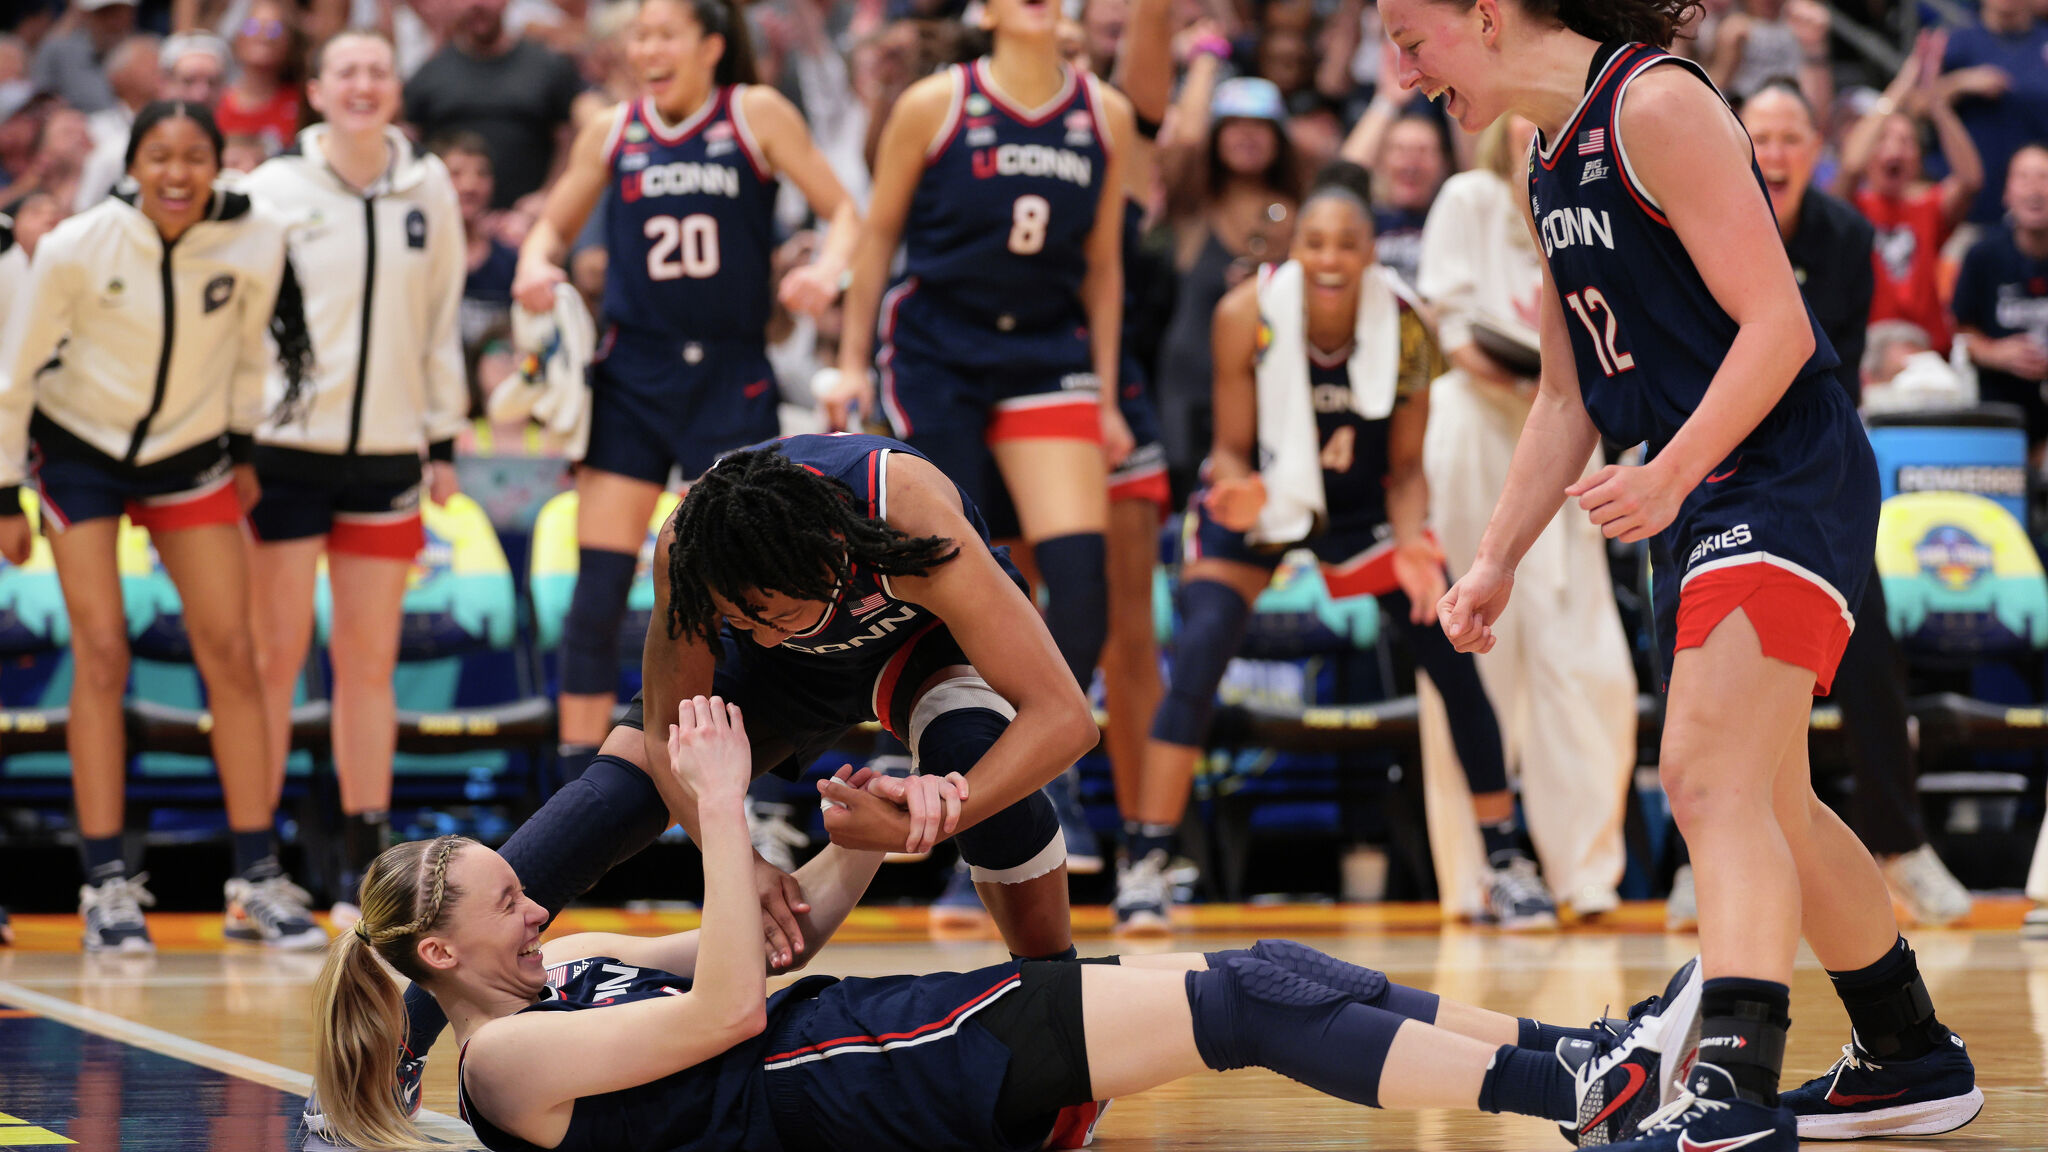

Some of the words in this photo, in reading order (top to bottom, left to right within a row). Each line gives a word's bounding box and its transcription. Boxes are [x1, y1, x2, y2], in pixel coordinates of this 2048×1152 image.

[621, 161, 740, 204] UCONN
[971, 142, 1091, 188] UCONN
[1581, 166, 1610, 181] EAST
[1584, 158, 1603, 170] BIG
[642, 213, 721, 282] 20
[1007, 193, 1051, 256] 8
[1564, 285, 1636, 378] 12
[1686, 523, 1753, 572] SKIES
